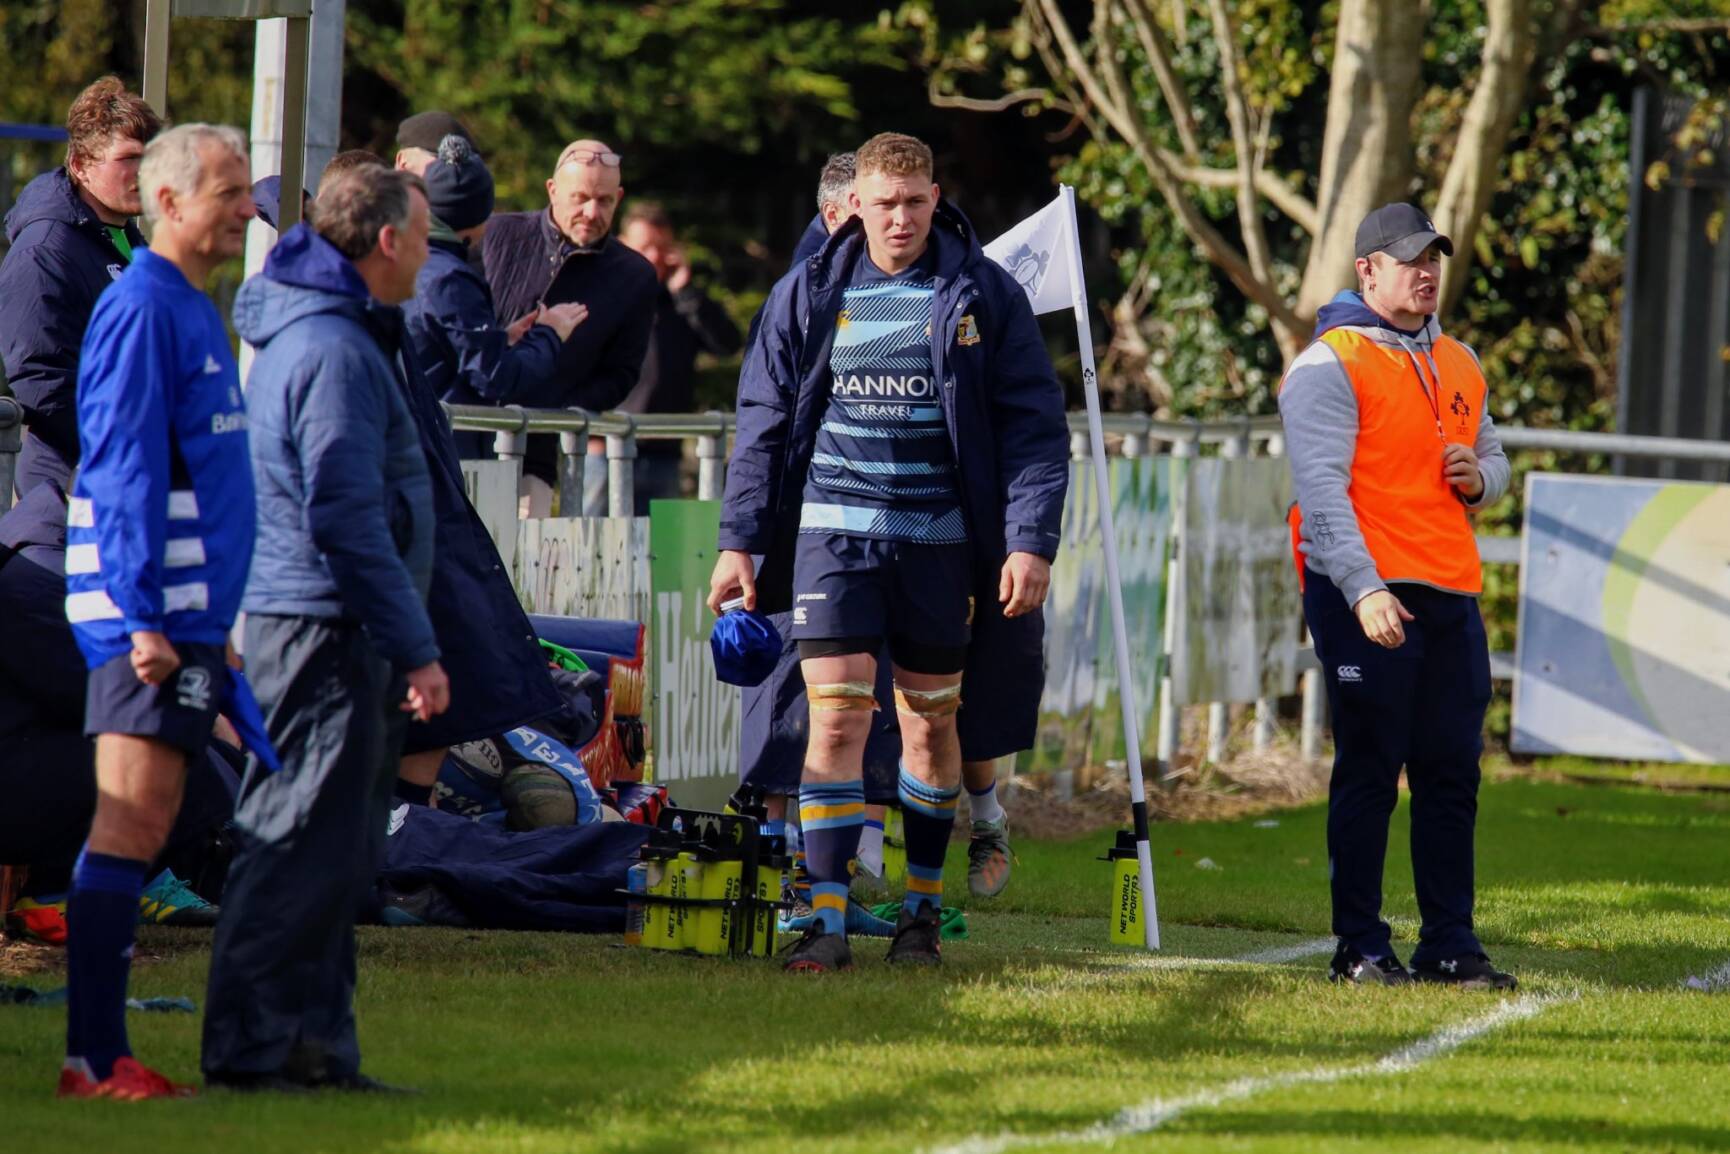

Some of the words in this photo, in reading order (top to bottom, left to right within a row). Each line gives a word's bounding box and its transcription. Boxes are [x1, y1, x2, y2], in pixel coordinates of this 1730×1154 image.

[860, 404, 913, 417] TRAVEL
[1122, 873, 1130, 911] WORLD
[1120, 912, 1128, 934] NET
